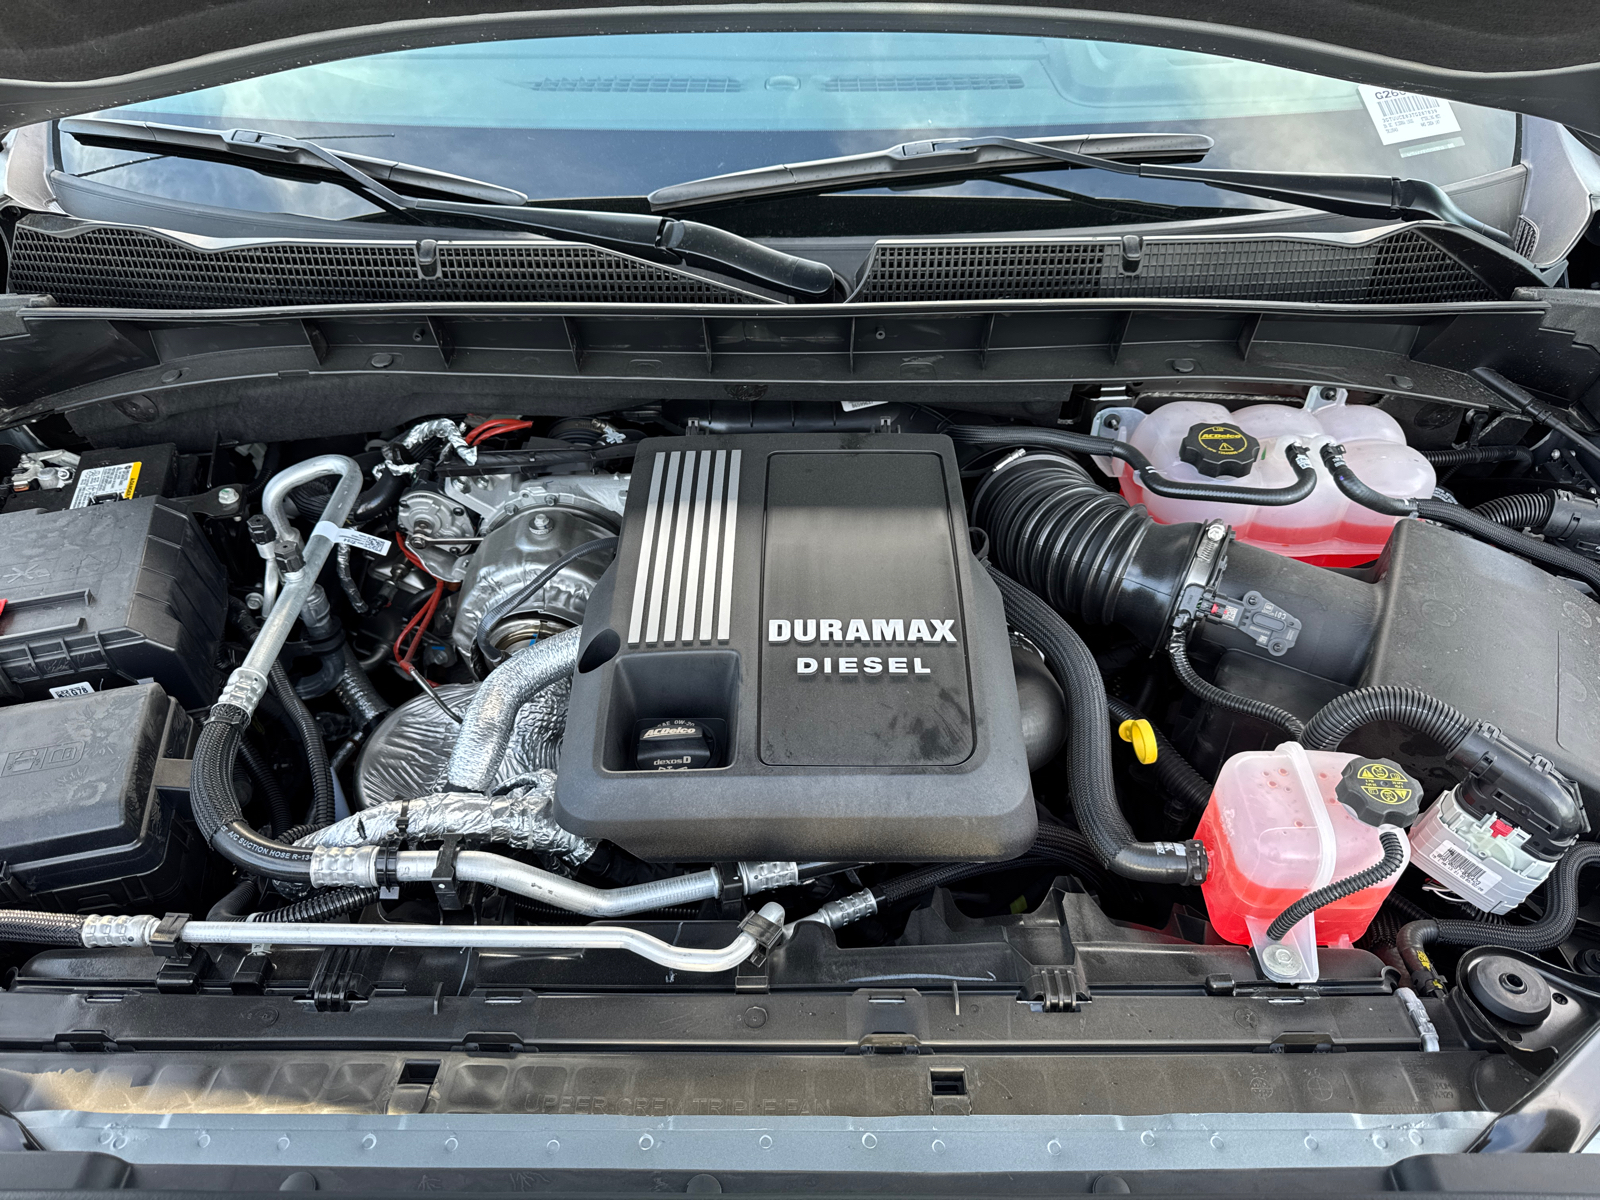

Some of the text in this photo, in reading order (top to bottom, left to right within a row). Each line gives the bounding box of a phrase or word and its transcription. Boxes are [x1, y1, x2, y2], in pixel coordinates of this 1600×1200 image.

[768, 618, 958, 645] DURAMAX
[796, 656, 932, 676] DIESEL
[642, 726, 696, 739] ACDelco
[227, 831, 240, 841] A/C
[238, 837, 270, 855] SUCTION
[269, 849, 292, 860] HOSE
[525, 1094, 608, 1114] UPPER
